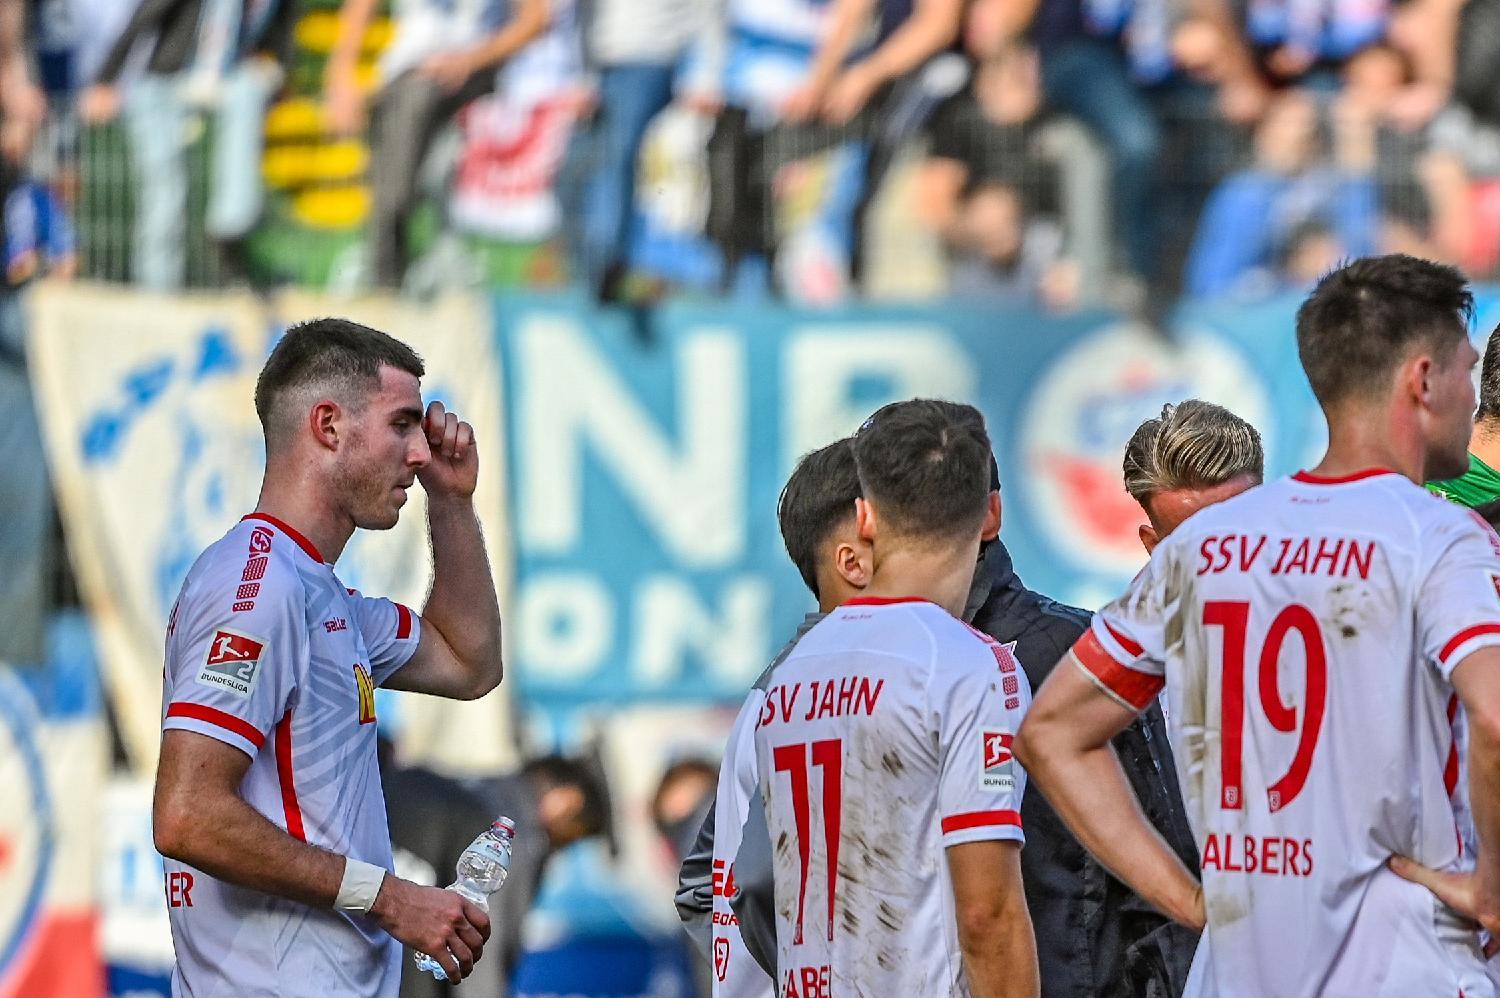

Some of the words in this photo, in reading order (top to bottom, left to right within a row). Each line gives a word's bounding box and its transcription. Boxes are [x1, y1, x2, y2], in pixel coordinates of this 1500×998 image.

[1197, 534, 1268, 577] SSV
[1270, 537, 1375, 580] JAHN
[200, 672, 248, 694] BUNDESLIGA
[804, 676, 884, 722] JAHN
[1202, 600, 1327, 814] 19
[772, 738, 842, 945] 11
[1201, 832, 1313, 877] ALBERS
